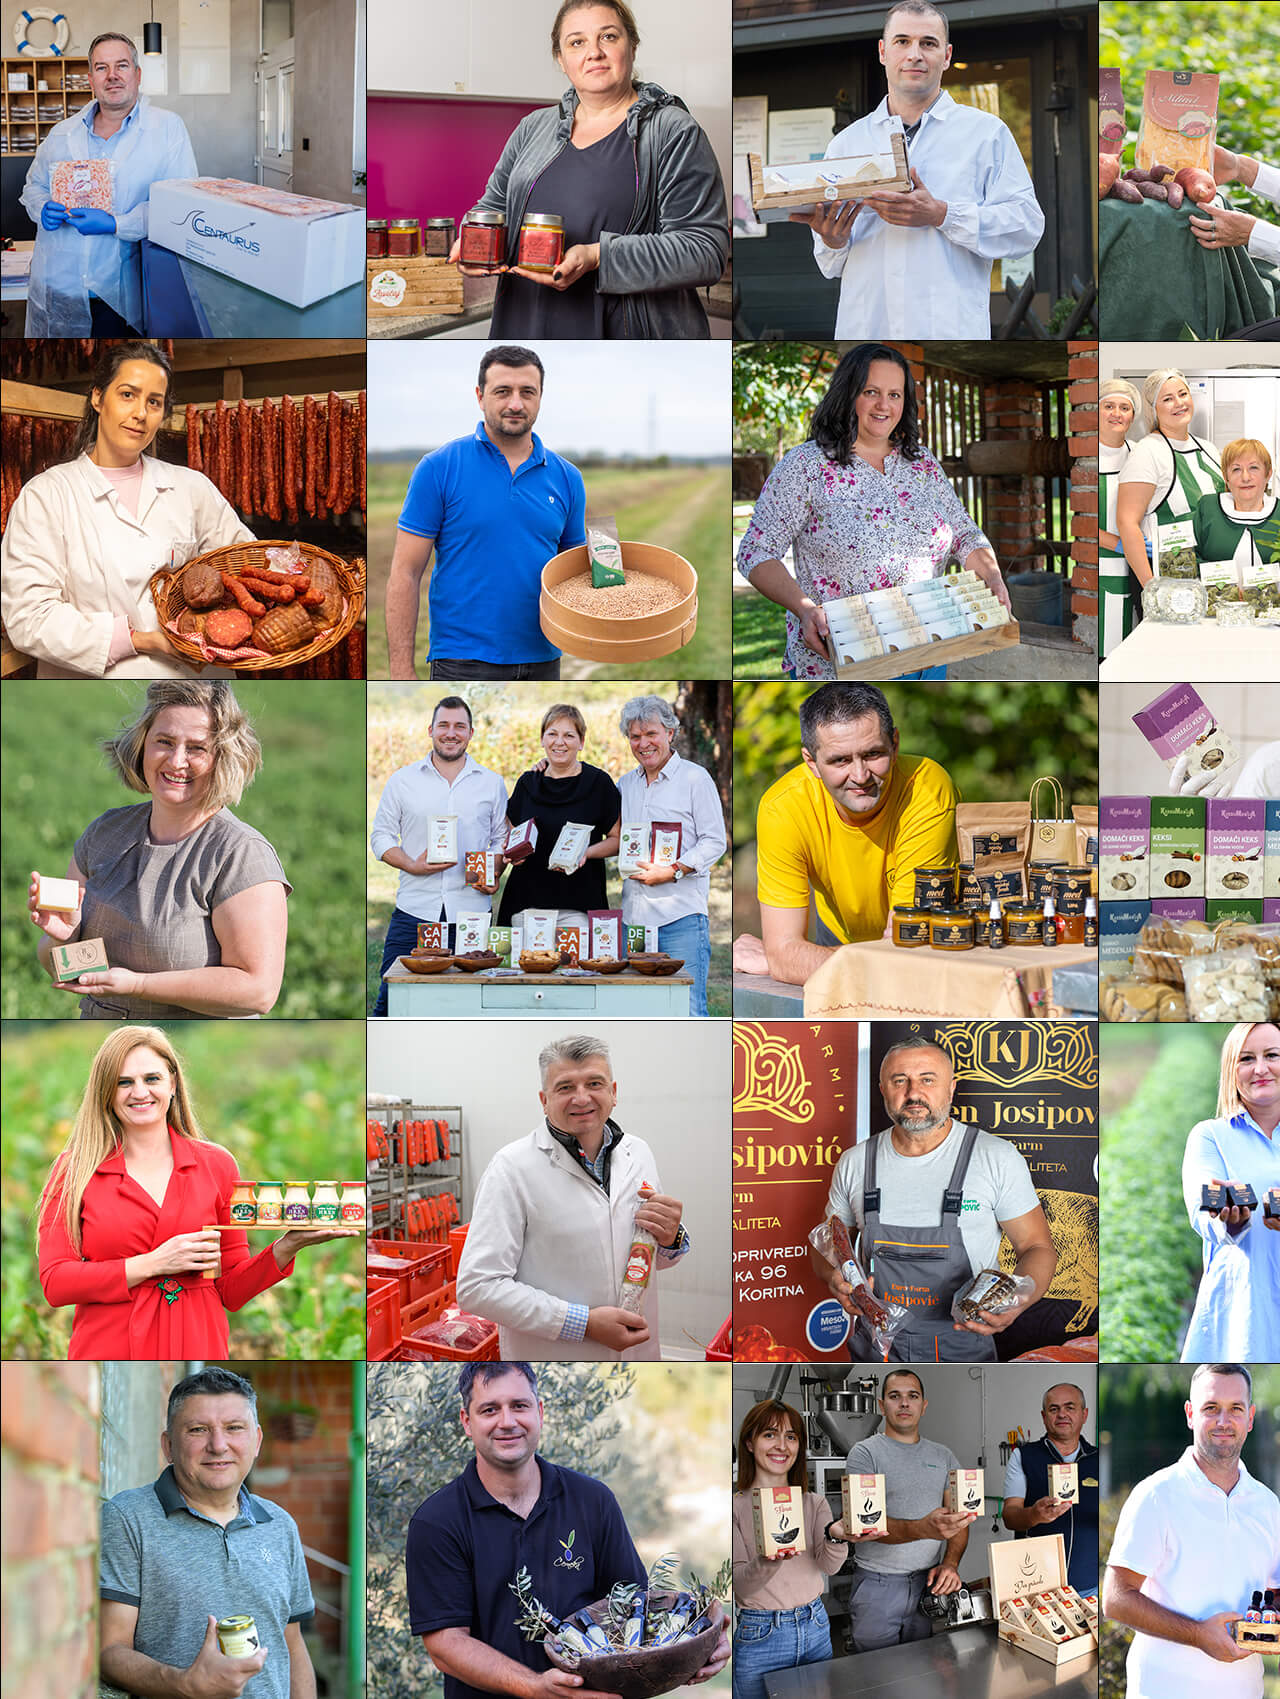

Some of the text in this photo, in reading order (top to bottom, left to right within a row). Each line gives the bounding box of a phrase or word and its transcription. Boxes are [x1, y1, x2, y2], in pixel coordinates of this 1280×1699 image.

[467, 854, 485, 864] CA
[1063, 890, 1083, 899] med
[424, 927, 440, 938] CA
[490, 931, 509, 941] DE
[559, 932, 578, 943] CA
[629, 928, 643, 939] DE
[987, 1029, 1033, 1072] KJ
[760, 1264, 787, 1280] 96
